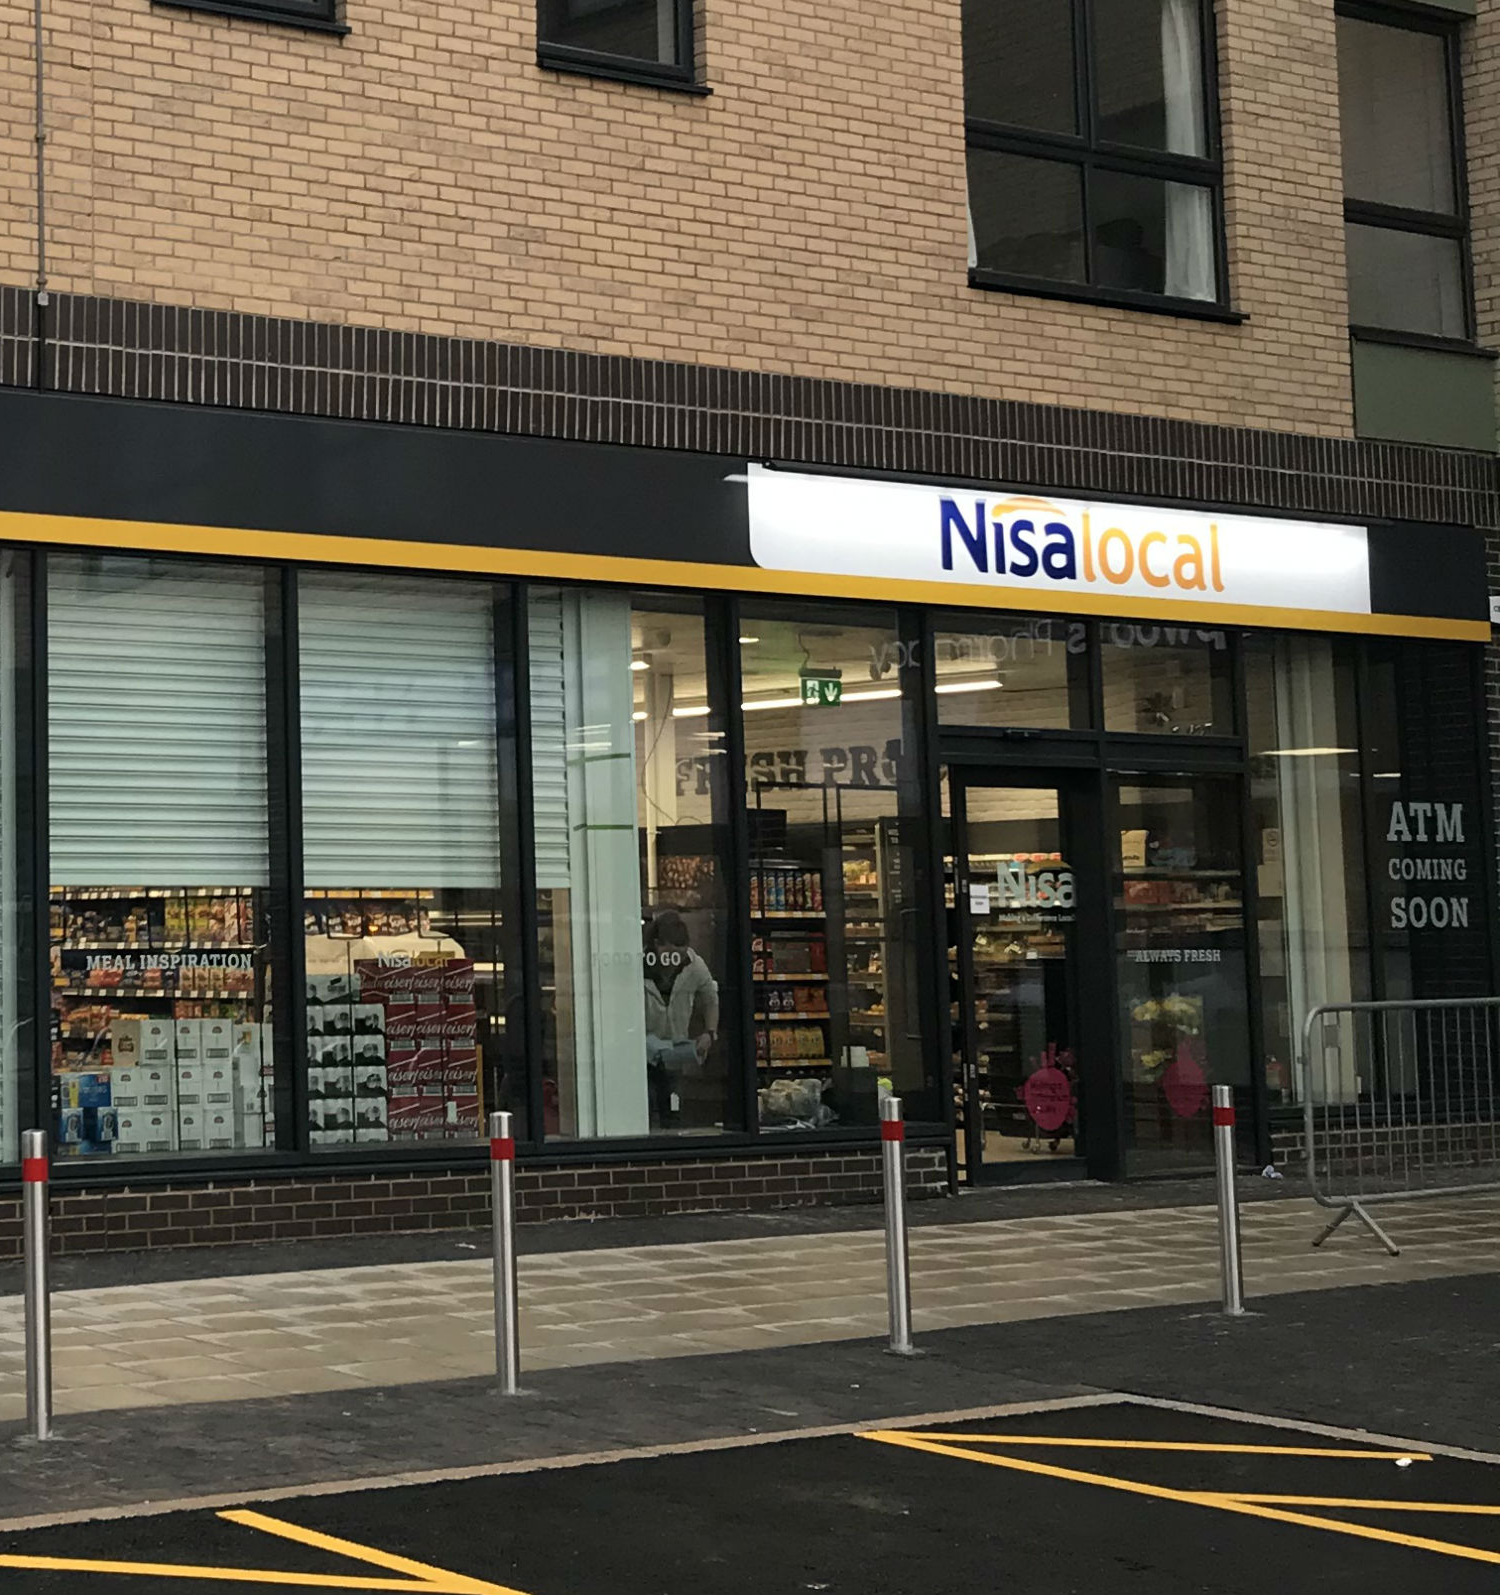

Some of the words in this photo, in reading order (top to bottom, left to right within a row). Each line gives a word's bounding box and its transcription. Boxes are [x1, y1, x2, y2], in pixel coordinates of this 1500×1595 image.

[1386, 800, 1466, 843] ATM
[1388, 858, 1468, 881] COMING
[996, 860, 1077, 909] Nisa
[1390, 896, 1470, 929] SOON
[86, 954, 135, 971] MEAL
[140, 953, 253, 971] INSPIRATION
[660, 951, 681, 967] GO
[1134, 949, 1182, 963] ALWAYS
[1182, 949, 1221, 962] FRESH
